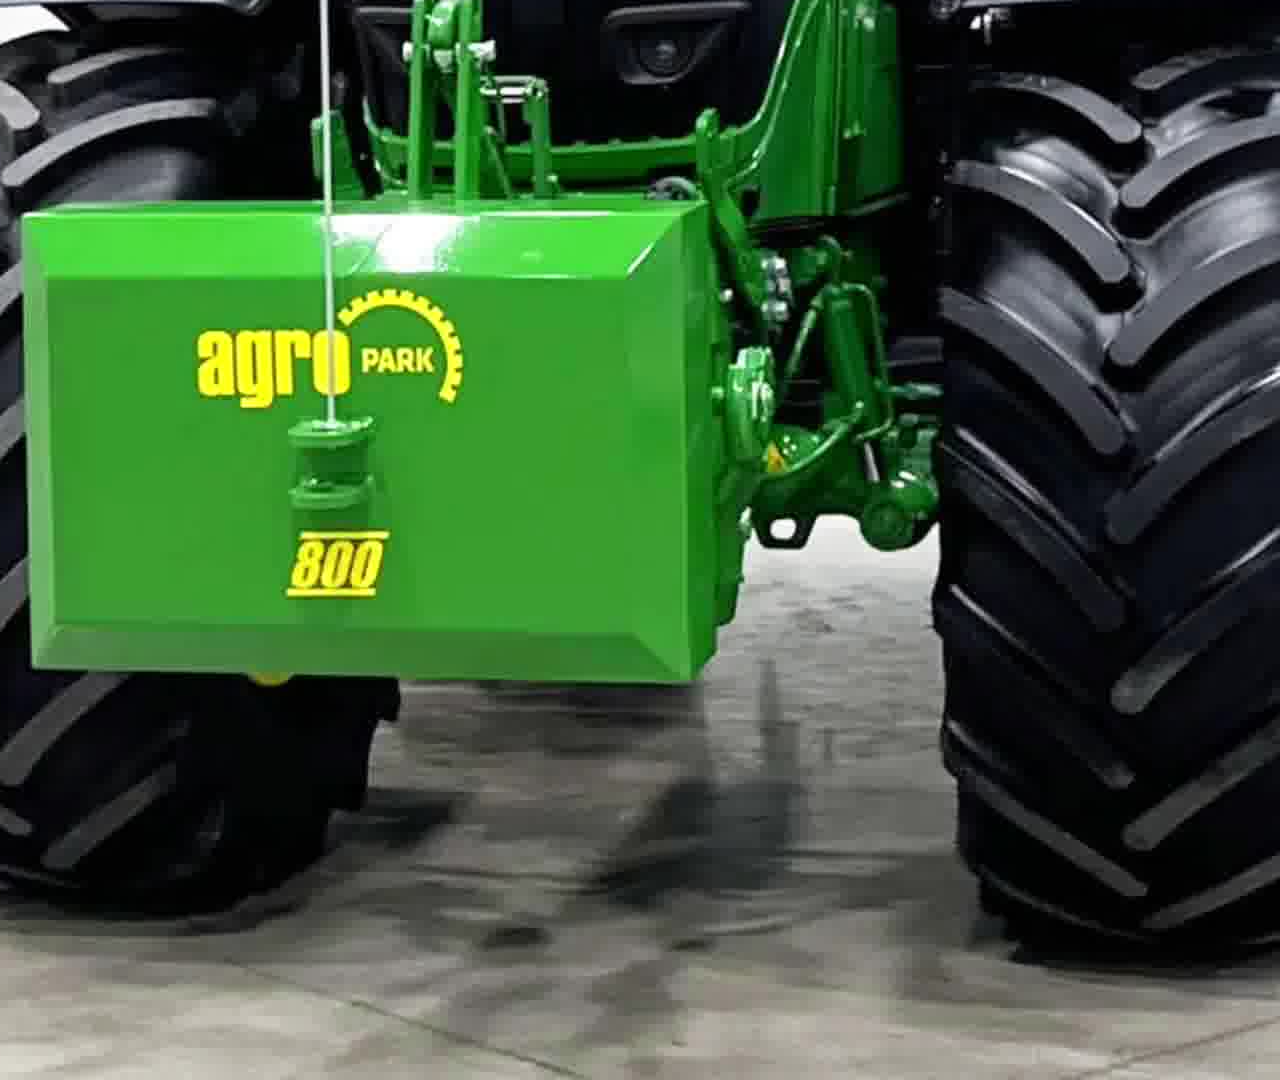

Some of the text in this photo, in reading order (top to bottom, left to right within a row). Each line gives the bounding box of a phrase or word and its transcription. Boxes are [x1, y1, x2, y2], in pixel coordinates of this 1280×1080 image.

[198, 329, 434, 408] agro PARK
[290, 538, 385, 590] 800
